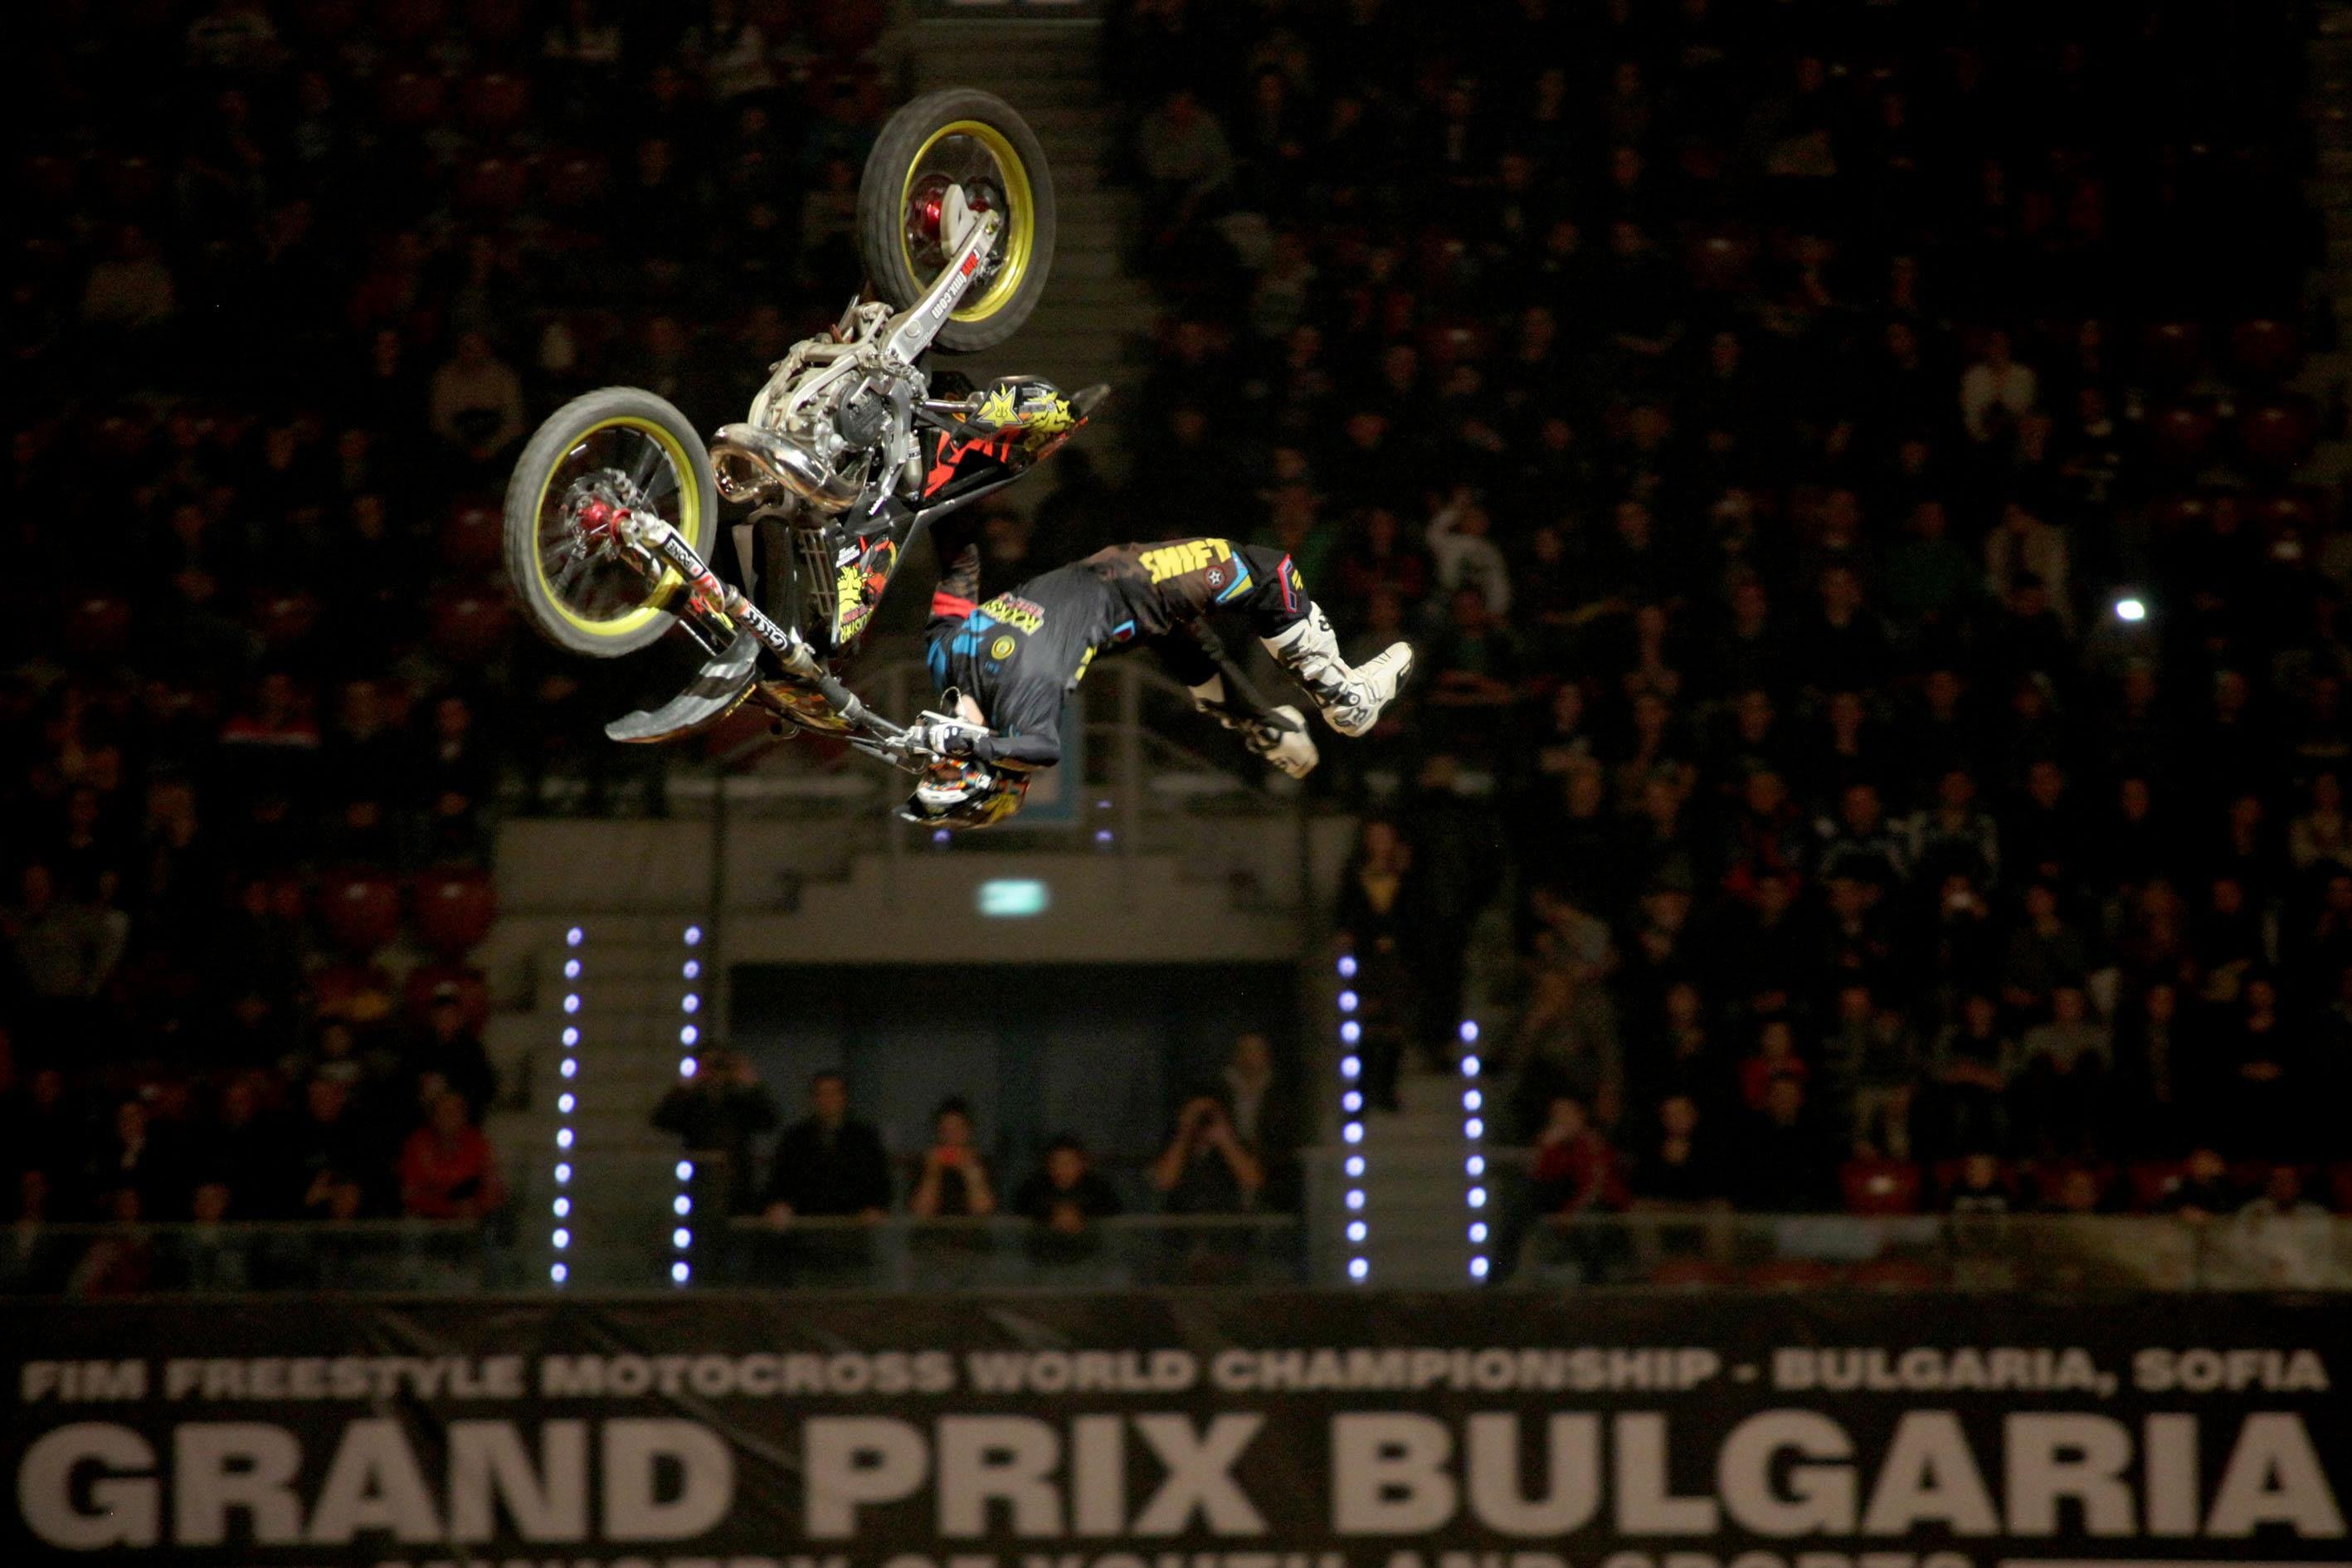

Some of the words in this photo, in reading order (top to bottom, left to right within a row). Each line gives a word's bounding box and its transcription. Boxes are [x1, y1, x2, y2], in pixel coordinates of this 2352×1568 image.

[21, 1359, 148, 1402] FIM
[164, 1354, 526, 1401] FREESTYLE
[540, 1350, 957, 1396] MOTOCROSS
[967, 1350, 1200, 1394] WORLD
[1209, 1347, 1720, 1392] CHAMPIONSHIP
[1771, 1346, 2117, 1398] BULGARIA,
[2132, 1346, 2330, 1392] SOFIA
[18, 1414, 737, 1549] GRAND
[802, 1412, 1267, 1539] PRIX
[1329, 1408, 2345, 1539] BULGARIA
